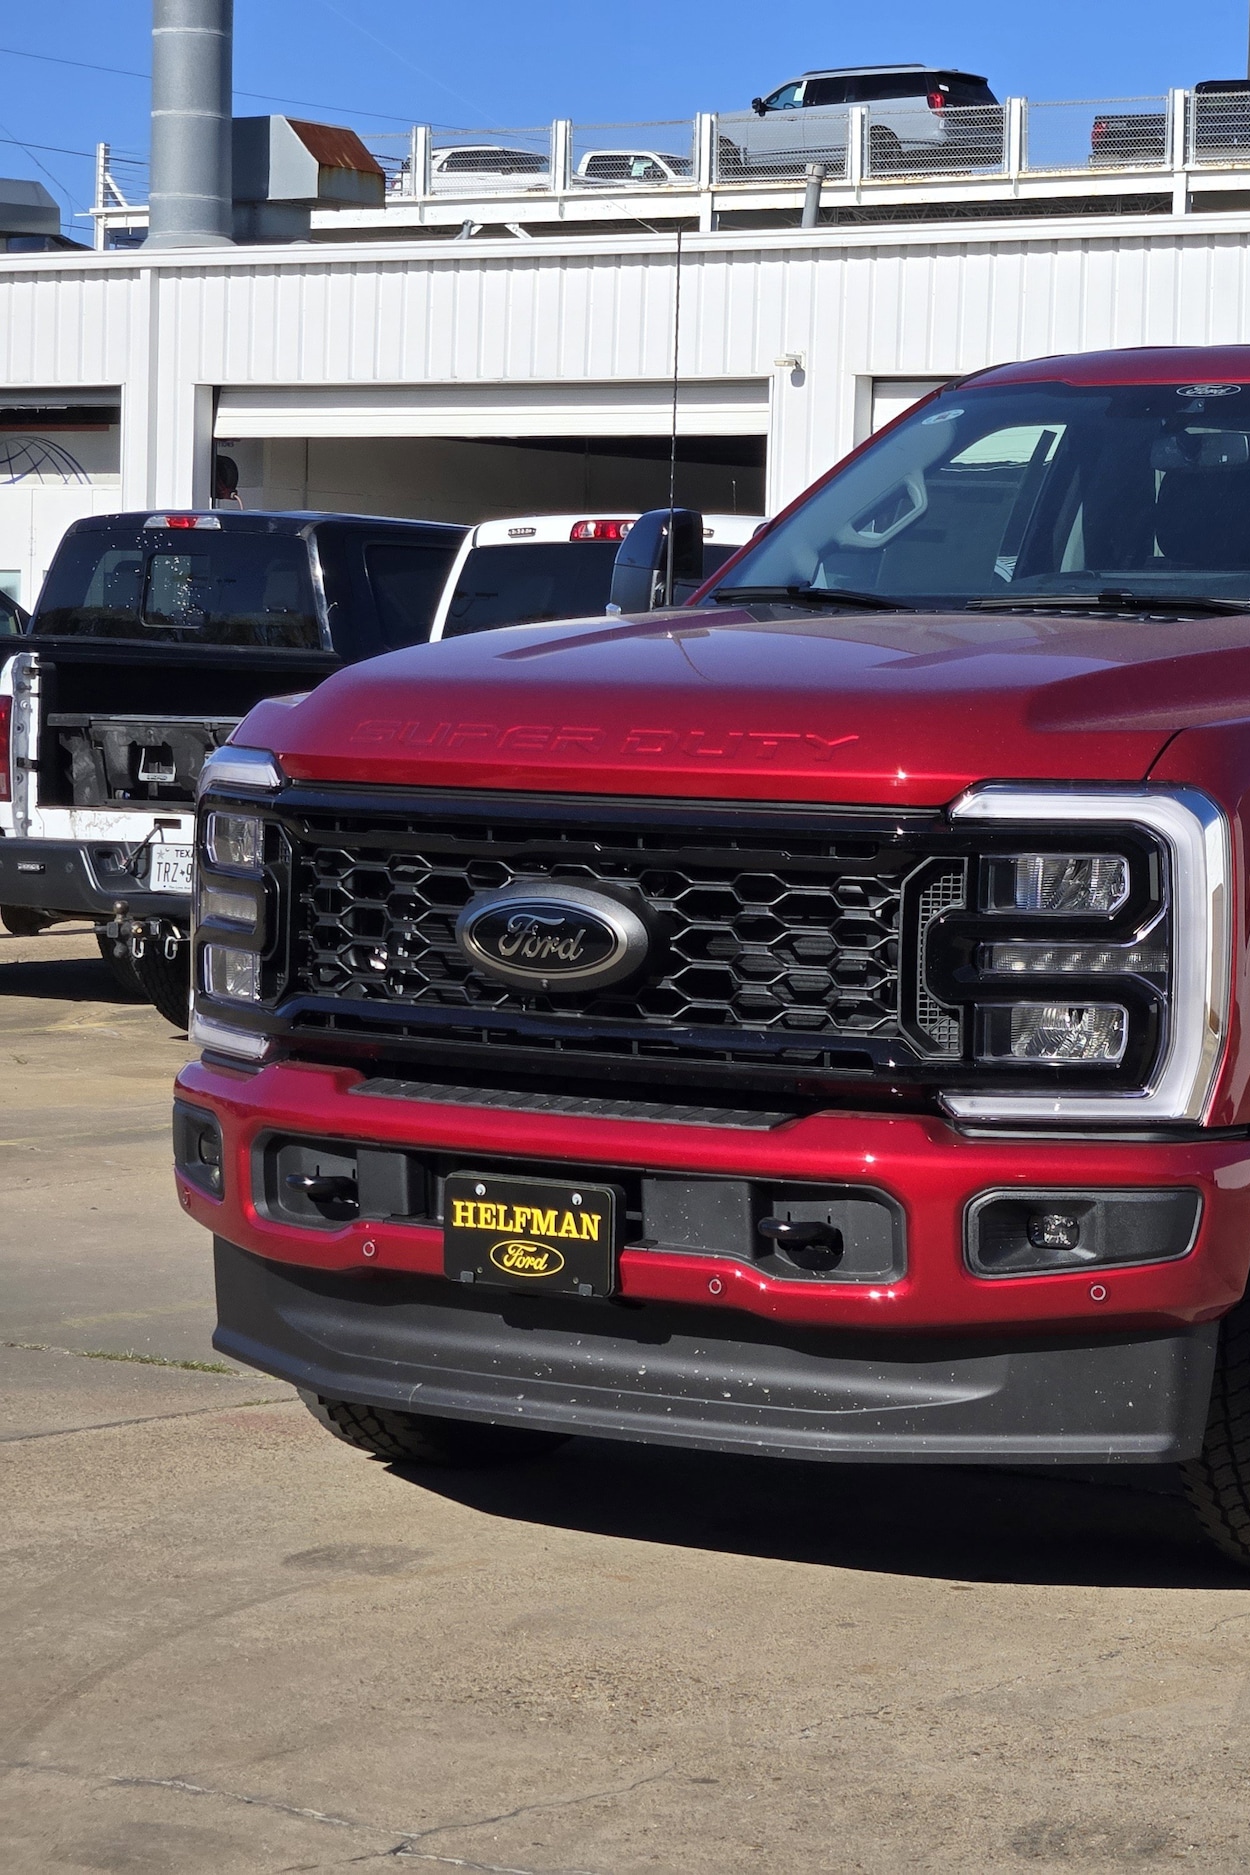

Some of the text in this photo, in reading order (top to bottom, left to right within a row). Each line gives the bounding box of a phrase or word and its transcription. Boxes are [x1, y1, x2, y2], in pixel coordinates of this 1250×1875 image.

[349, 719, 861, 762] SUPER DUTY
[496, 912, 587, 962] Ford
[451, 1199, 602, 1242] HELFMAN
[502, 1242, 550, 1272] Ford
